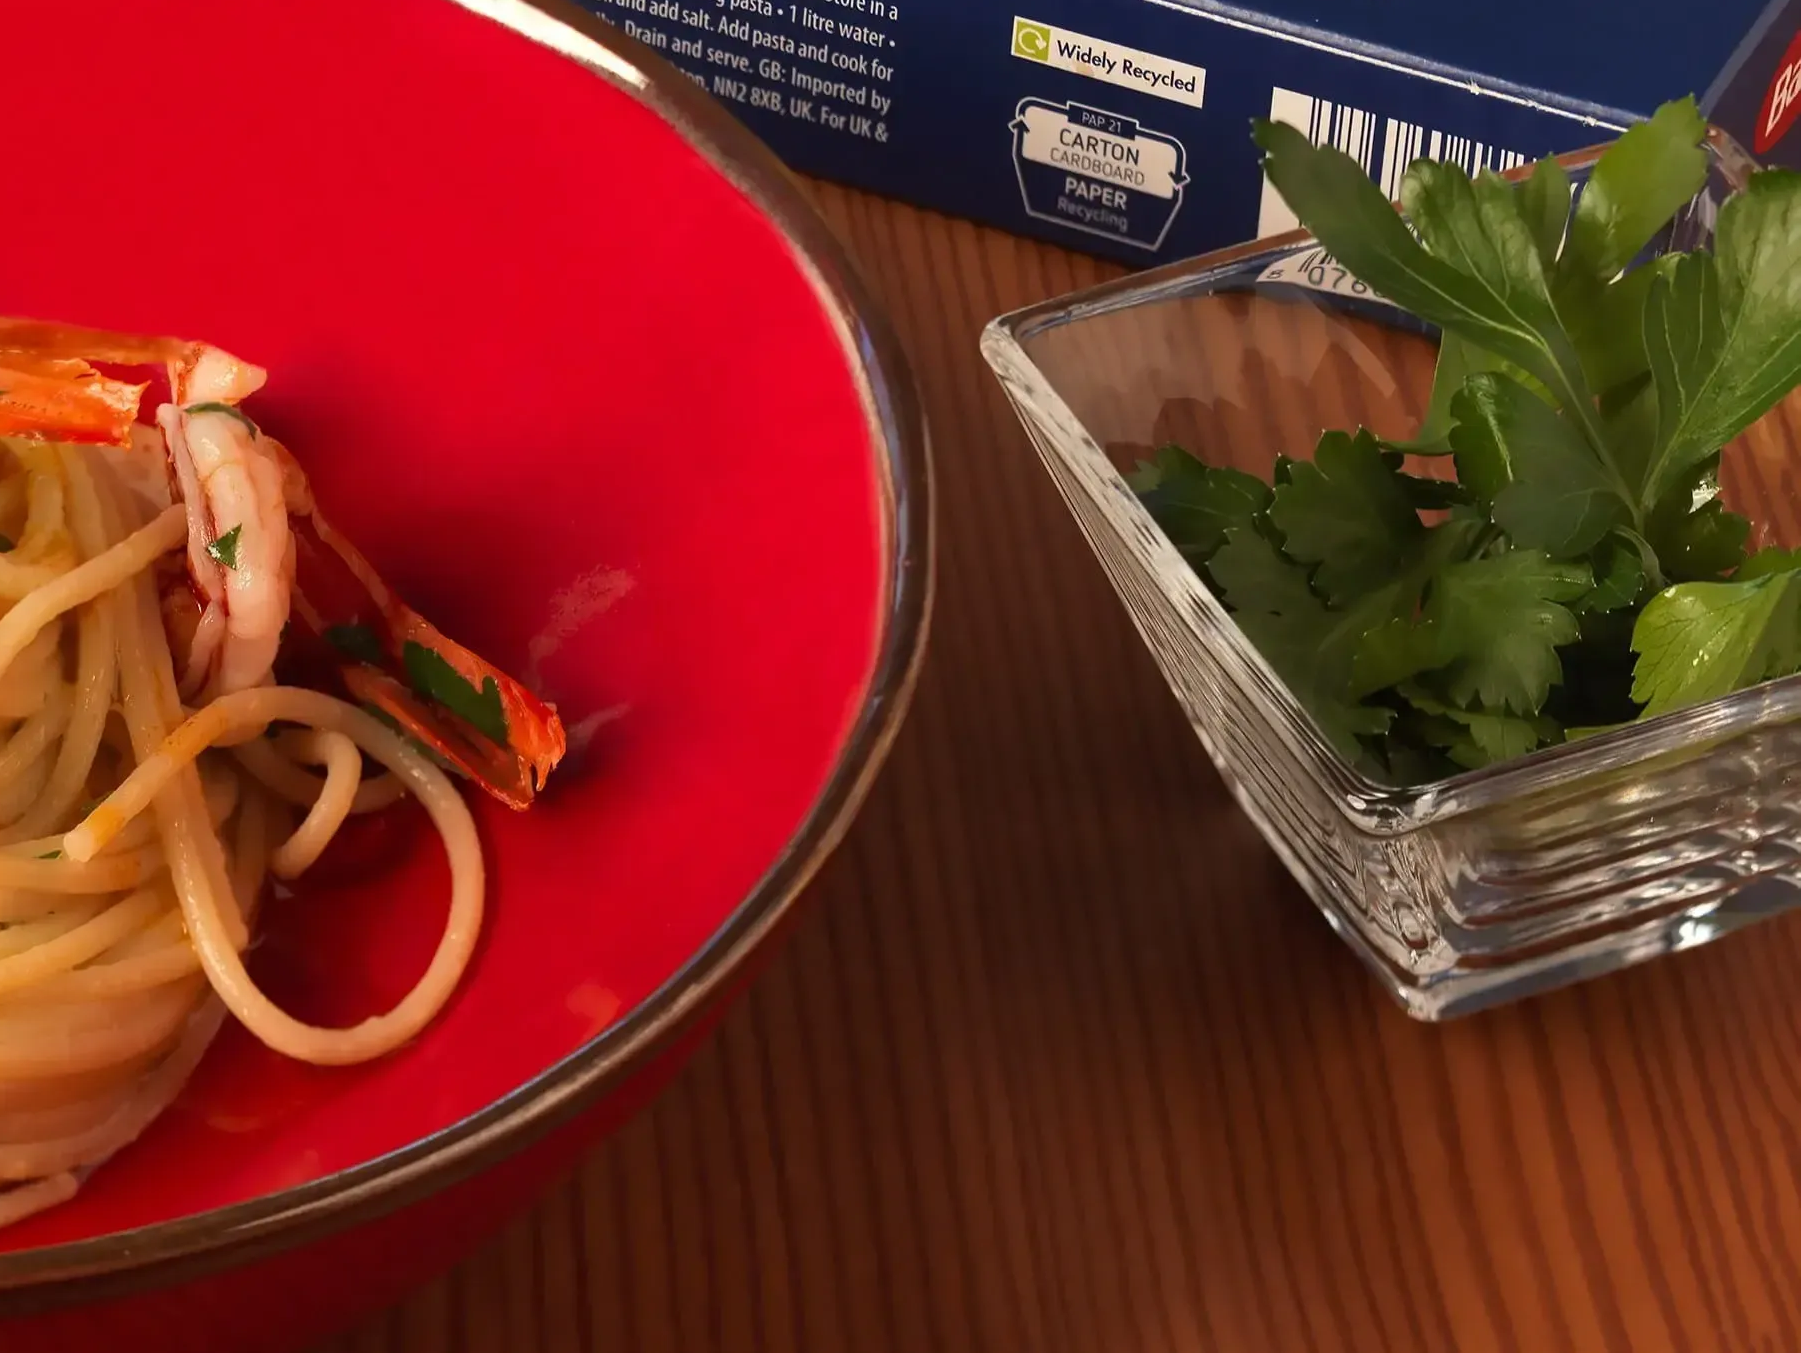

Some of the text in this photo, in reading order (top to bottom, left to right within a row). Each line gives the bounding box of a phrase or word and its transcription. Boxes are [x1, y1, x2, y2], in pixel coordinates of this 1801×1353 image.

[789, 4, 797, 24] 1
[802, 9, 835, 35] litre
[839, 22, 885, 49] water
[889, 5, 899, 21] a
[649, 0, 679, 21] add
[682, 9, 714, 32] salt.
[717, 15, 749, 41] Add
[752, 29, 795, 55] pasta
[798, 40, 828, 64] and
[831, 49, 868, 75] cook
[871, 57, 894, 83] for
[624, 20, 891, 116] Drain and serve. GB: Imported by
[1057, 40, 1196, 93] Widely Recycled
[714, 75, 747, 100] NN2
[749, 87, 786, 116] 8XB,
[790, 97, 816, 123] UK.
[820, 105, 847, 131] For
[849, 112, 872, 138] UK
[874, 120, 890, 143] &
[1081, 112, 1122, 133] PAP 21
[1050, 147, 1145, 187] CARDBOARD
[1060, 128, 1140, 166] CARTON
[1065, 177, 1128, 210] PAPER
[1057, 196, 1128, 233] Recycling
